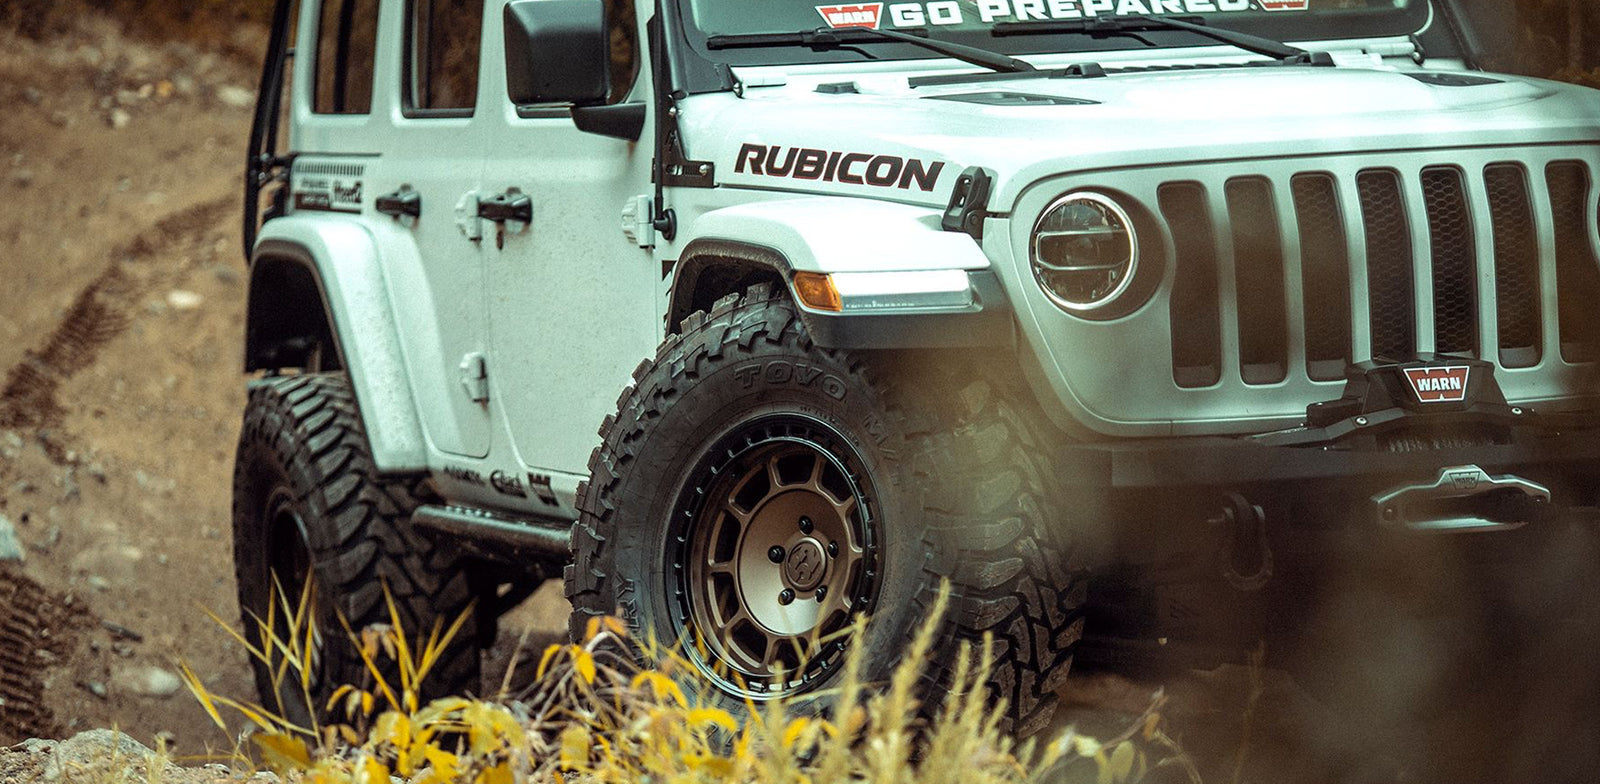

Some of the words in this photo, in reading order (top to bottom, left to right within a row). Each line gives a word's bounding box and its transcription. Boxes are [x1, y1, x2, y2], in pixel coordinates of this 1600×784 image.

[827, 10, 876, 25] WARN
[889, 0, 964, 27] GO
[734, 143, 945, 192] RUBICON
[734, 360, 849, 401] TOYO
[1417, 377, 1461, 391] WARN
